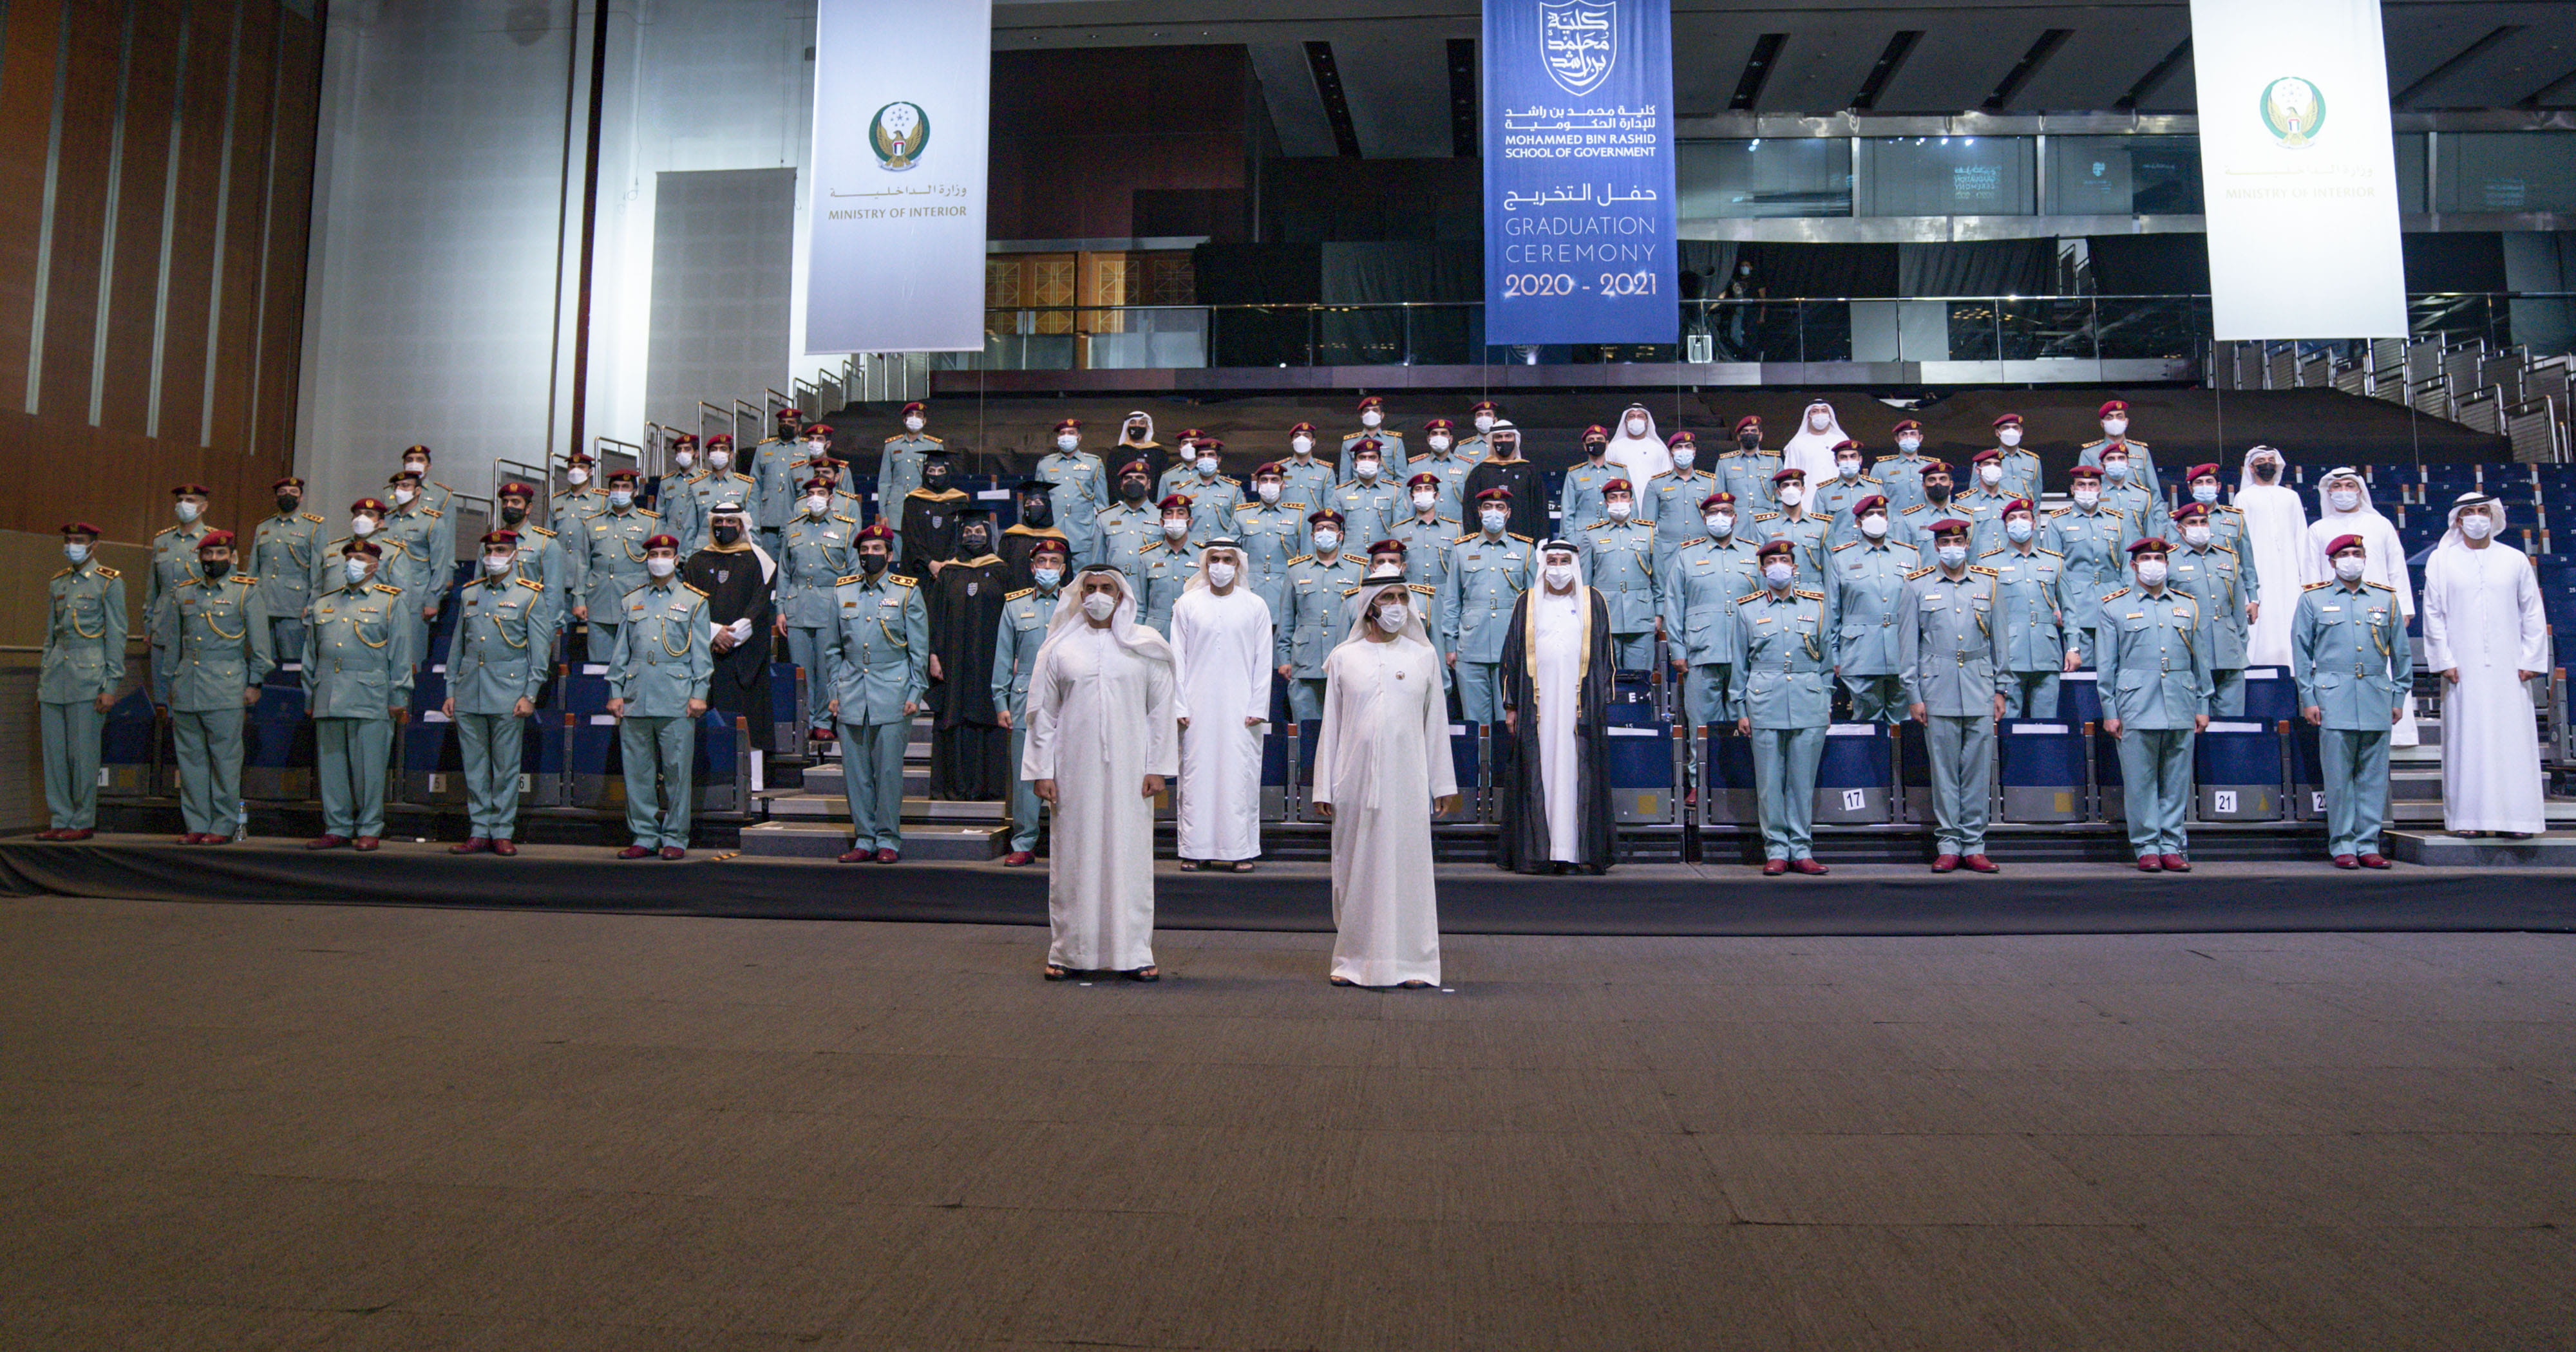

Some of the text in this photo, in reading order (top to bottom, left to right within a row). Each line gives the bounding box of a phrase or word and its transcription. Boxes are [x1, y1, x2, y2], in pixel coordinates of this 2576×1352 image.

[1505, 104, 1656, 118] كلية محمد بن راشد
[1505, 118, 1616, 132] الحكومية
[1505, 133, 1656, 146] MOHAMMED BIN RASHID
[1505, 146, 1656, 158] SCHOOL OF GOVERNMENT
[938, 185, 967, 197] وزارة
[1504, 183, 1657, 211] حفل التخريج
[2226, 187, 2376, 199] MINISTRY OF INTERIOR
[828, 205, 967, 220] MINISTRY OF INTERIOR
[1506, 216, 1654, 236] GRADUATION
[1506, 244, 1656, 263] CEREMONY
[1505, 274, 1573, 296] 2020
[1600, 272, 1656, 296] 2021
[434, 777, 440, 789] 5
[519, 776, 524, 789] 6
[1847, 792, 1860, 807] 17
[2219, 795, 2230, 810] 21
